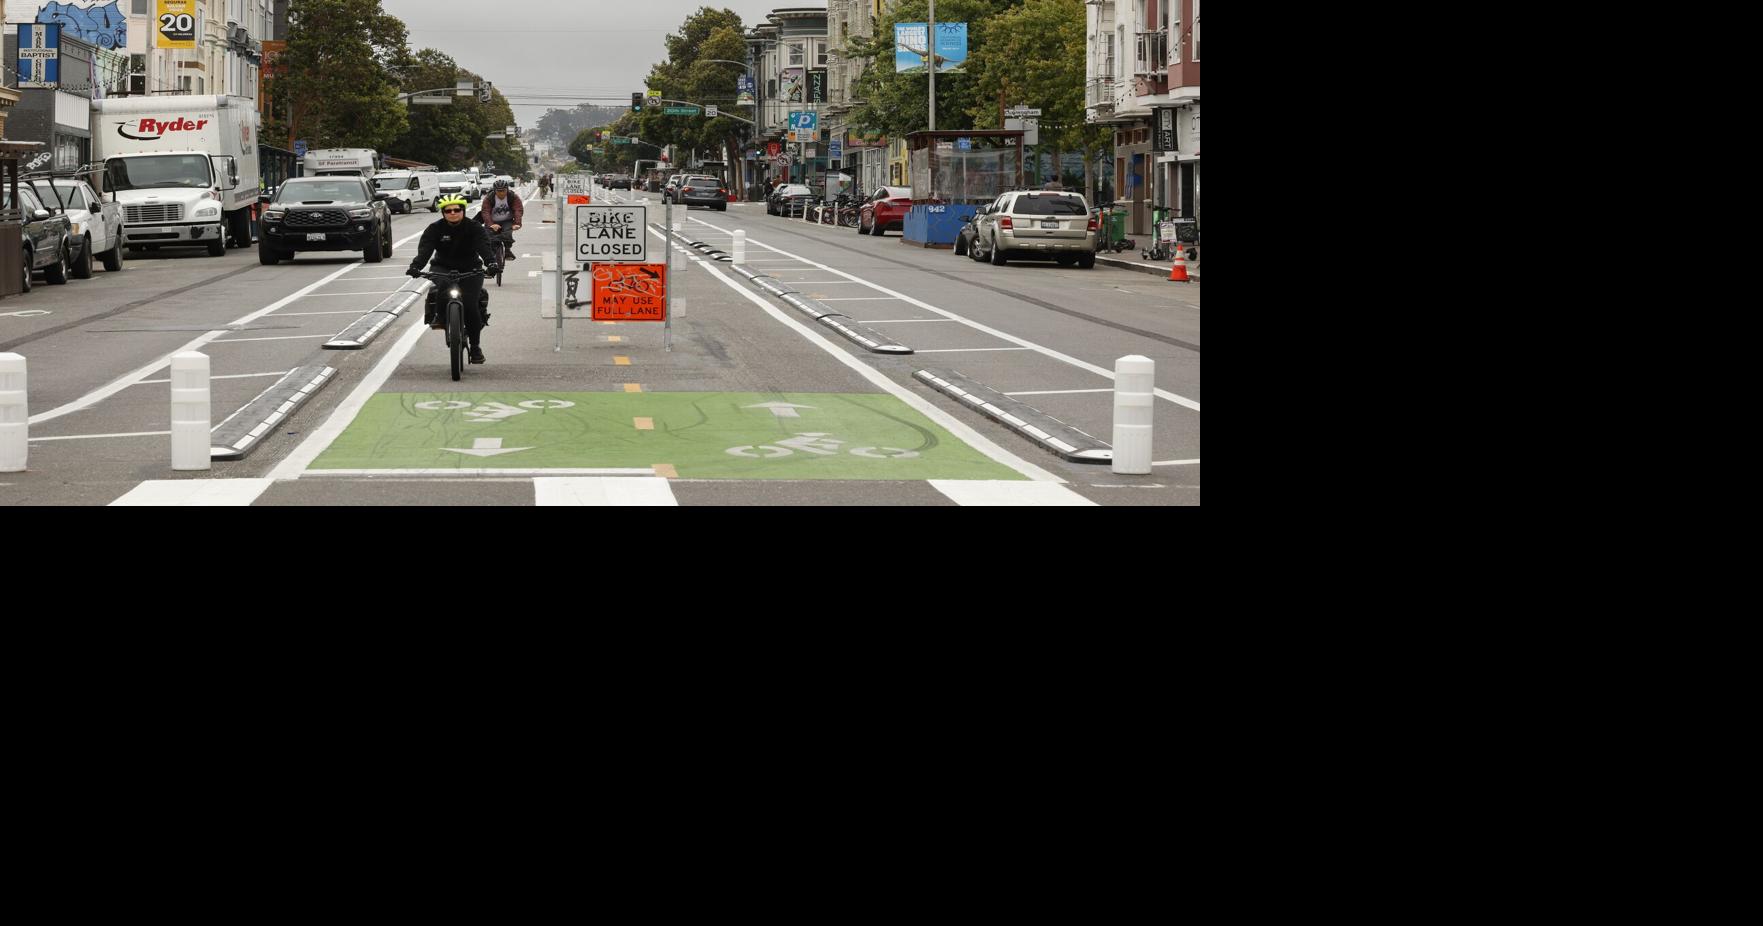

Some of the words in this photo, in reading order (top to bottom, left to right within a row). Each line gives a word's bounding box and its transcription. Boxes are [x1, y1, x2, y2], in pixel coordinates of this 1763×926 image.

[160, 13, 193, 32] 20
[1163, 110, 1171, 129] CITY
[138, 117, 208, 136] Ryder
[589, 211, 635, 224] BIKE
[587, 227, 637, 239] LANE
[580, 243, 642, 255] CLOSED
[603, 296, 626, 305] MAY
[633, 296, 654, 305] USE
[597, 306, 624, 315] FULL
[630, 306, 659, 315] LANE
